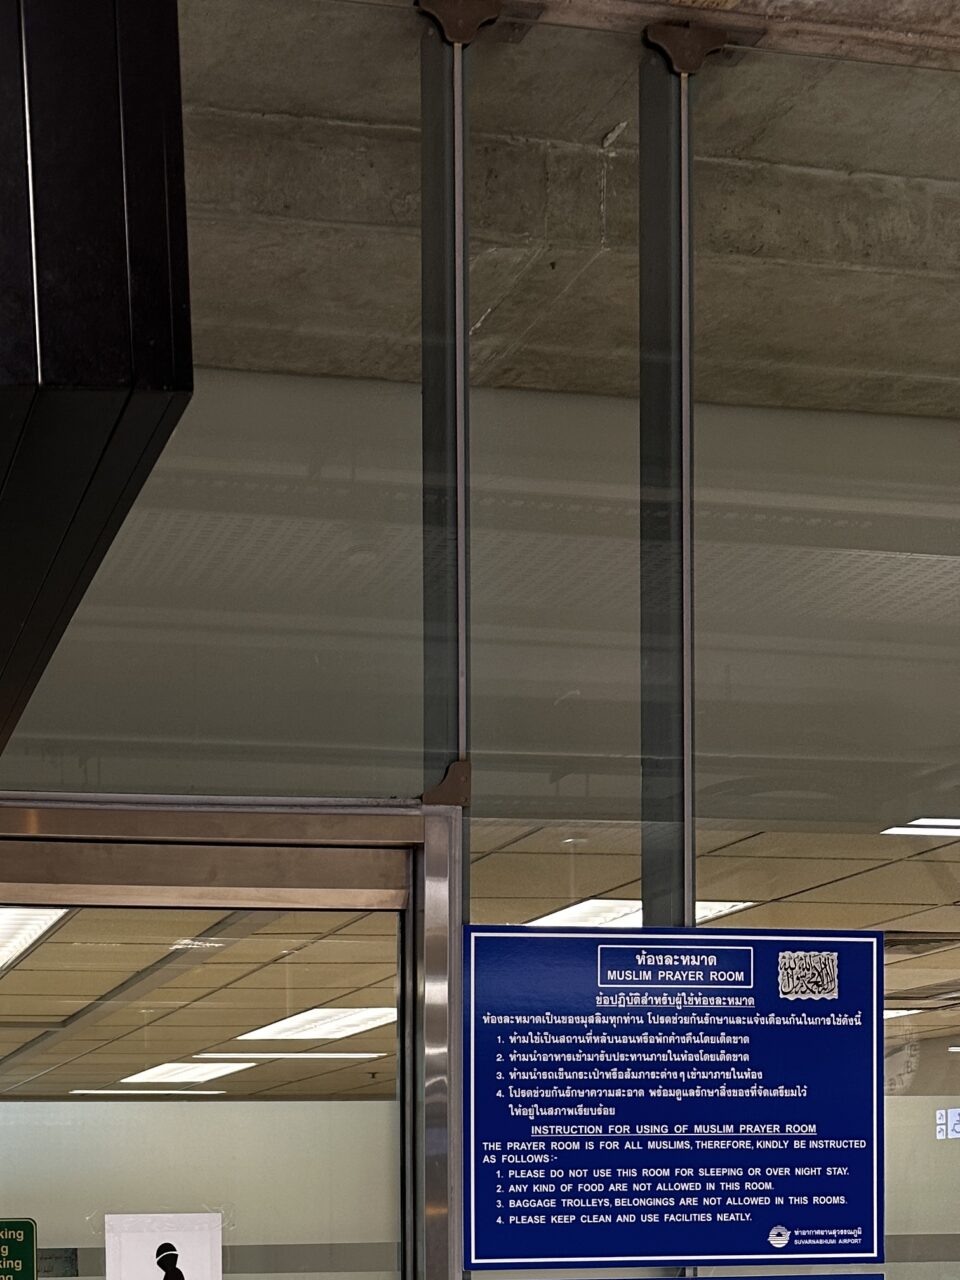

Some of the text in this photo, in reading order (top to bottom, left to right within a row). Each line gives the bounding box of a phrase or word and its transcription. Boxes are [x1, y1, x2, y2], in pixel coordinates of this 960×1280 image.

[636, 950, 716, 966] ห้องละหมาด
[608, 970, 744, 981] MUSLIM PRAYER ROOM
[531, 1124, 816, 1135] INSTRUCTION FOR USING OF MUSLIM PRAYER ROOM
[482, 1142, 501, 1150] THE
[507, 1142, 545, 1150] PRAYER
[551, 1142, 580, 1150] ROOM
[586, 1142, 594, 1150] IS
[600, 1141, 619, 1149] FOR
[624, 1141, 643, 1149] ALL
[756, 1140, 789, 1148] KINDLY
[794, 1140, 806, 1148] BE
[810, 1140, 866, 1148] INSTRUCTED
[483, 1155, 496, 1163] AS
[496, 1170, 503, 1178] 1.
[509, 1170, 545, 1178] PLEASE
[550, 1170, 564, 1178] DO
[569, 1169, 588, 1177] NOT
[593, 1169, 612, 1177] USE
[642, 1168, 670, 1176] ROOM
[675, 1168, 694, 1176] FOR
[698, 1168, 743, 1176] SLEEPING
[748, 1168, 761, 1176] OR
[766, 1168, 790, 1176] OVER
[509, 1184, 528, 1192] ANY
[533, 1184, 555, 1192] KIND
[560, 1184, 573, 1192] OF
[578, 1184, 604, 1192] FOOD
[608, 1183, 628, 1191] ARE
[633, 1183, 652, 1191] NOT
[720, 1182, 740, 1190] THIS
[496, 1200, 504, 1208] 3.
[509, 1199, 556, 1208] BAGGAGE
[615, 1198, 675, 1206] BELONGINGS
[703, 1197, 722, 1205] NOT
[726, 1197, 770, 1205] ALLOWED
[788, 1196, 808, 1204] THIS
[496, 1216, 504, 1224] 4.
[510, 1216, 546, 1224] PLEASE
[551, 1215, 576, 1223] KEEP
[580, 1215, 611, 1223] CLEAN
[616, 1214, 636, 1222] AND
[641, 1214, 659, 1222] USE
[664, 1214, 712, 1222] FACILITIES
